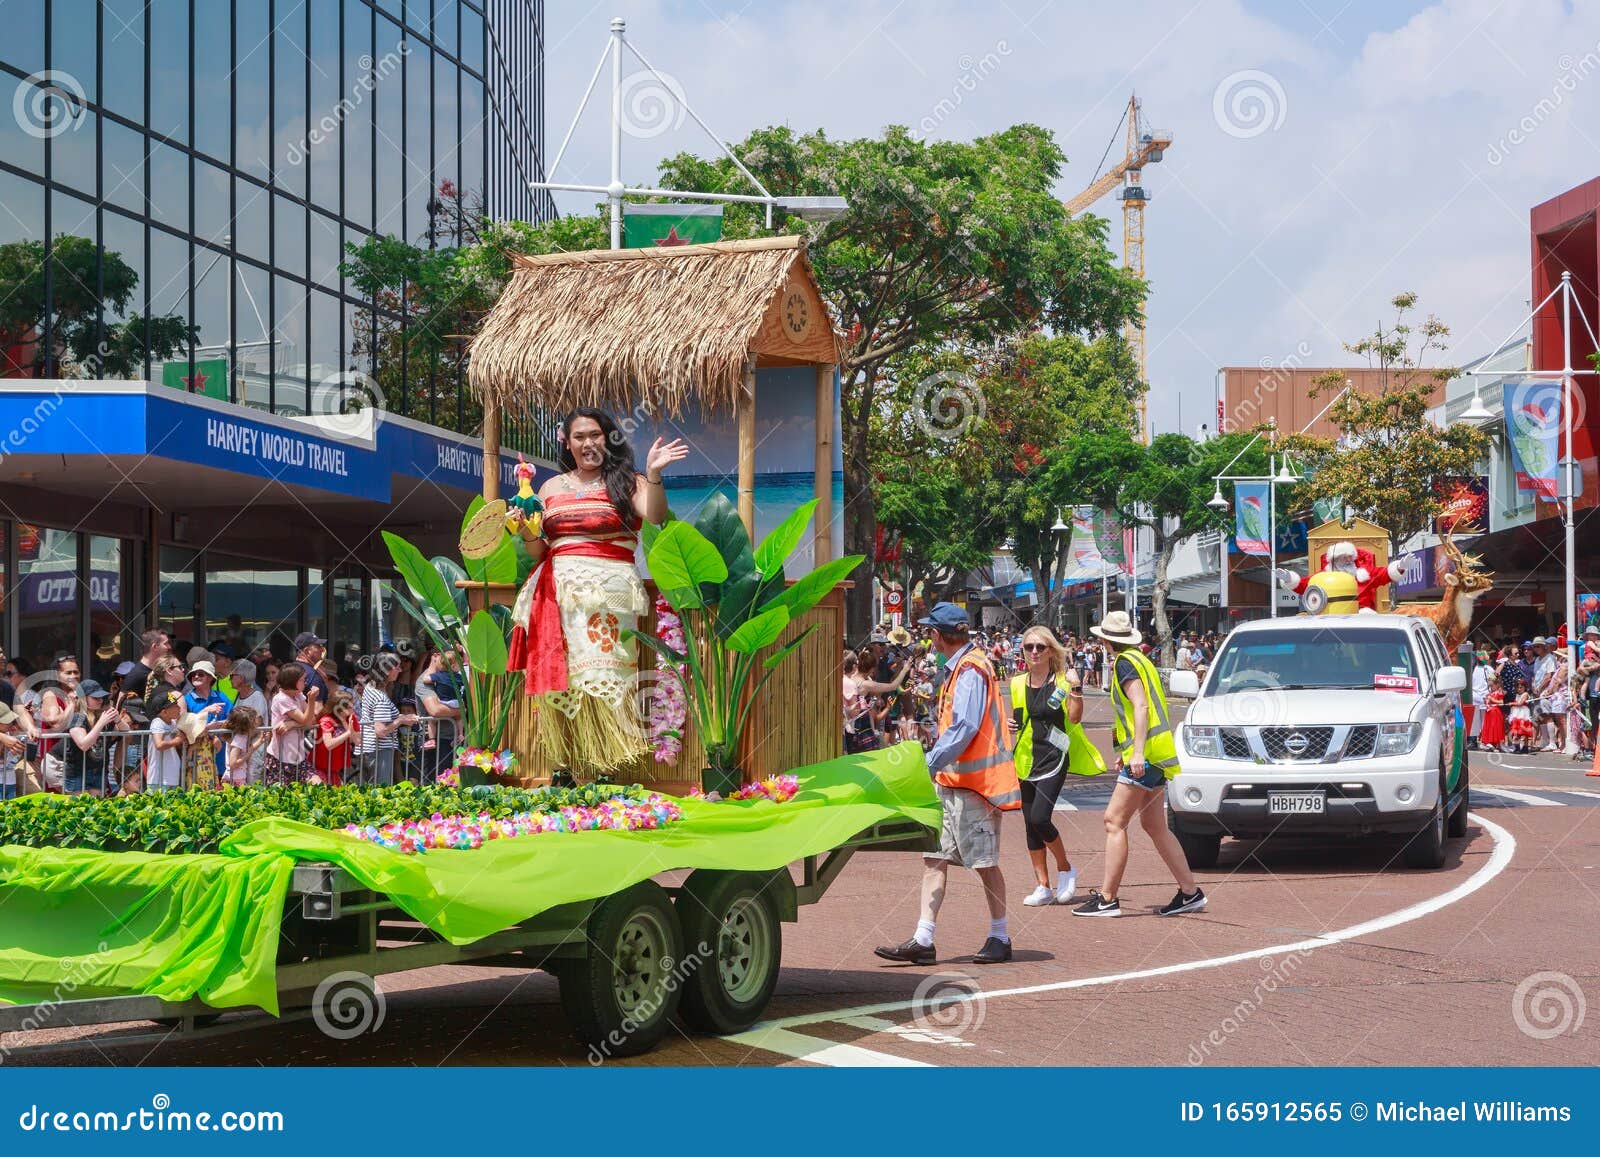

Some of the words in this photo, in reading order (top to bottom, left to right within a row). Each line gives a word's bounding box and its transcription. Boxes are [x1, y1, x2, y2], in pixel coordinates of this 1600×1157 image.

[207, 418, 259, 456] HARVEY
[261, 431, 305, 466] WORLD
[307, 443, 349, 477] TRAVEL
[437, 443, 473, 474] HARVEY
[1271, 797, 1322, 812] HBH798
